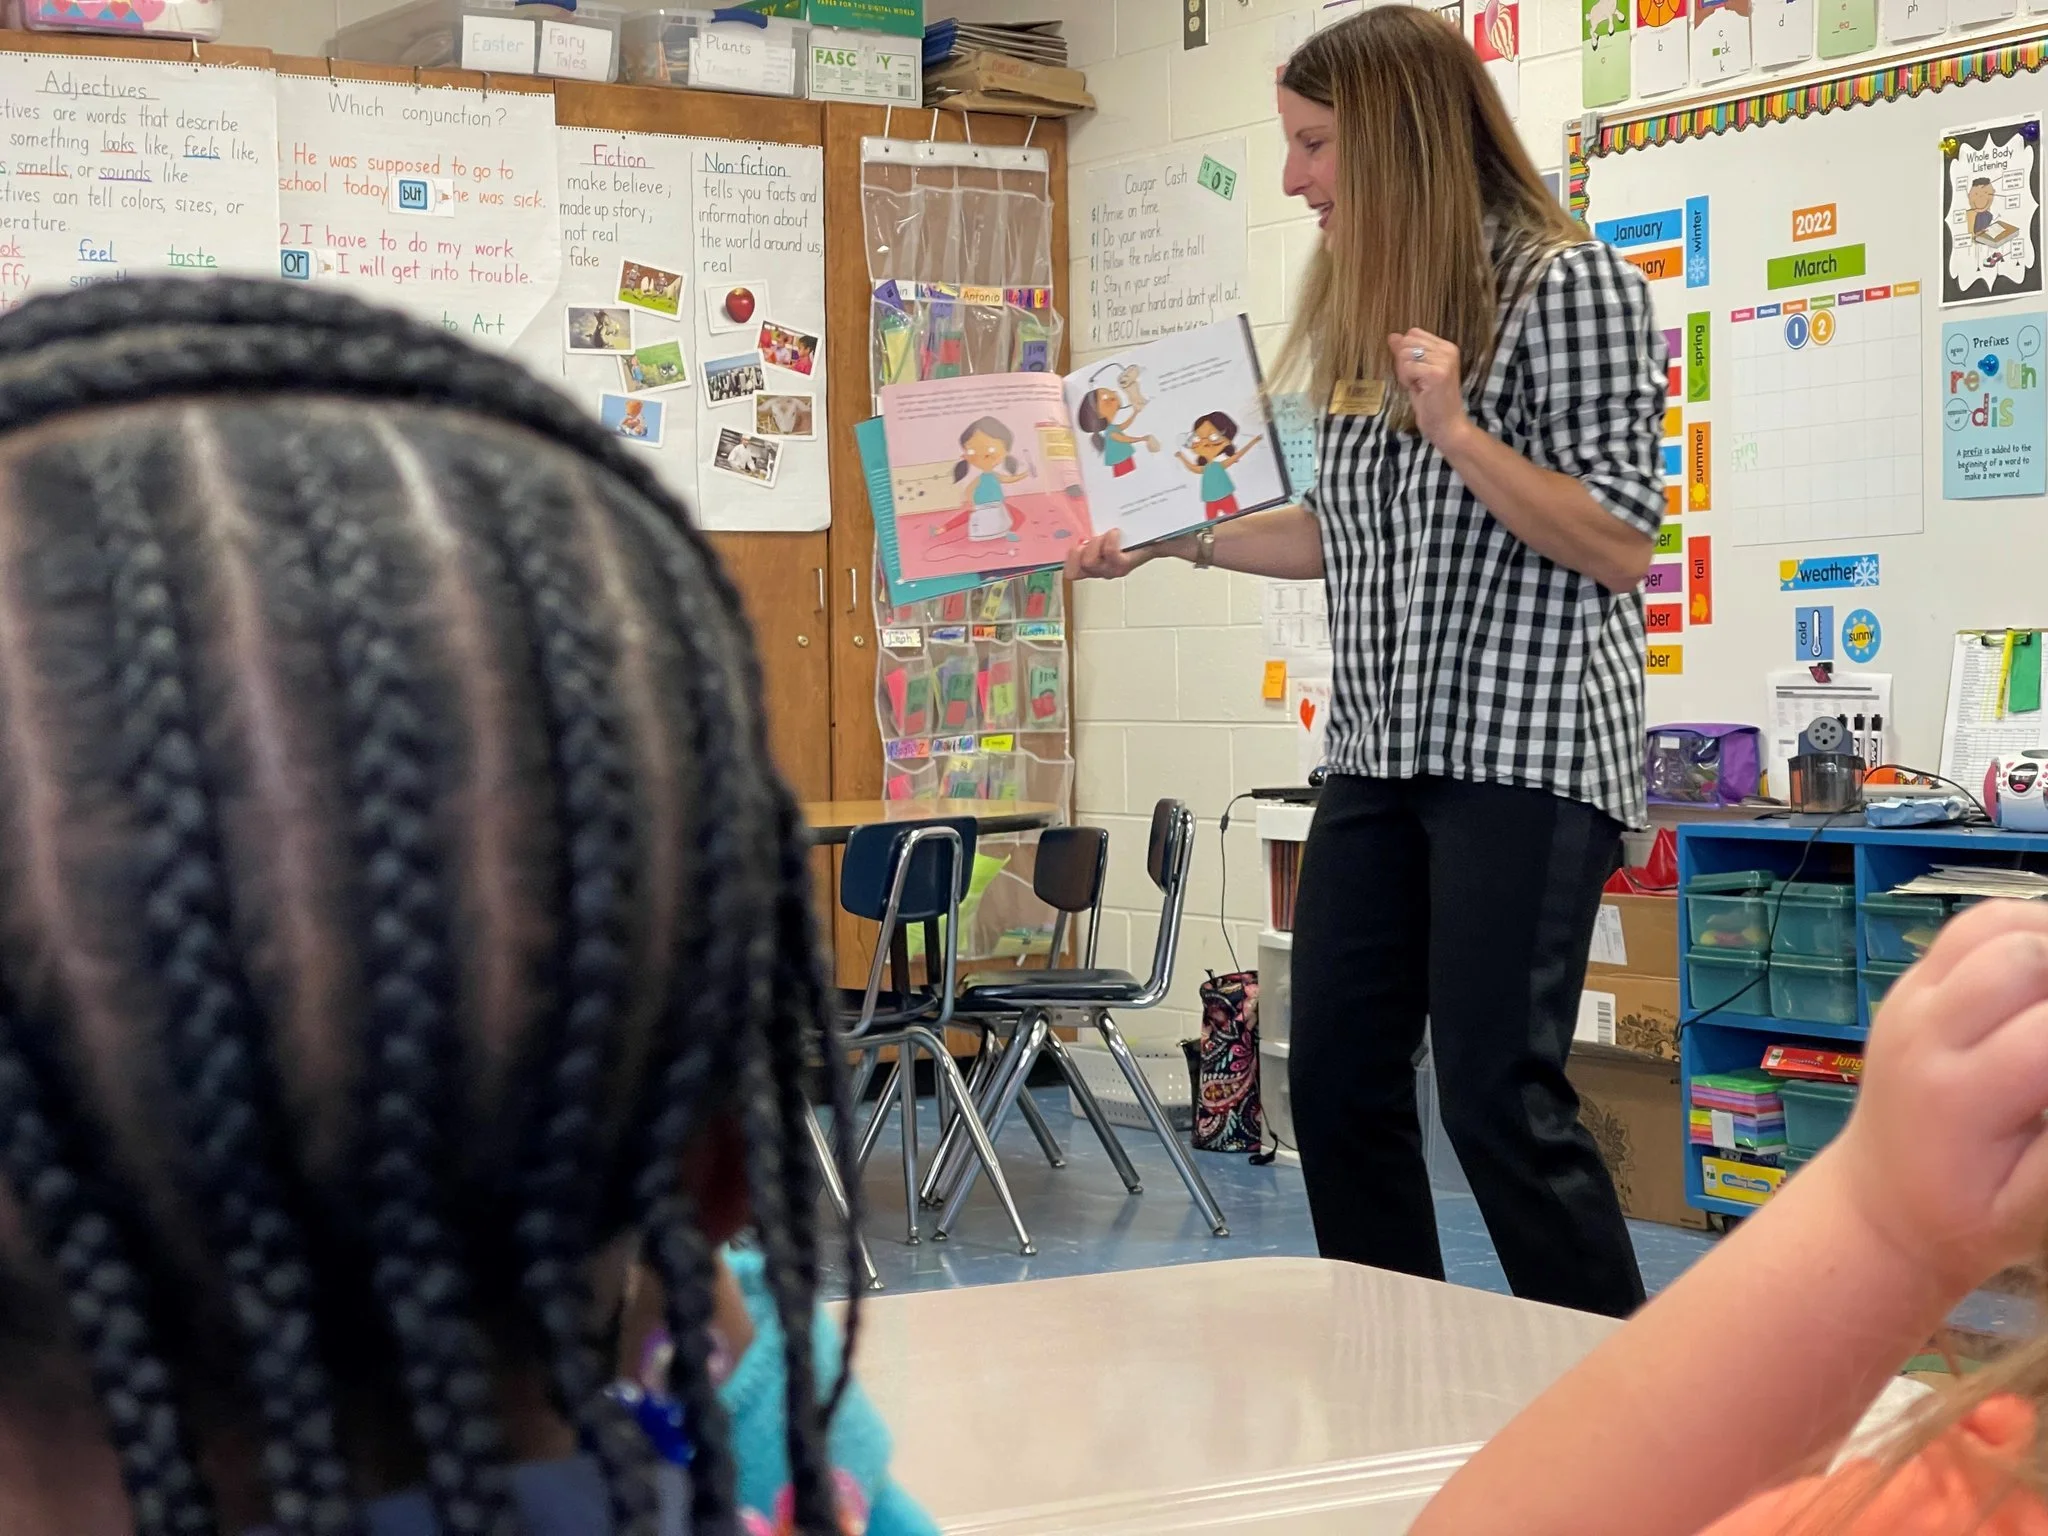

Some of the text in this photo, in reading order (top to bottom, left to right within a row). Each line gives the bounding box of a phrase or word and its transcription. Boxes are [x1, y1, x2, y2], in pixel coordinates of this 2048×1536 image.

[1779, 13, 1785, 27] d
[1908, 0, 1918, 19] ph
[472, 32, 524, 53] Easter
[549, 28, 585, 55] Fairy
[706, 34, 751, 55] Plants
[1658, 39, 1664, 52] b
[553, 52, 588, 70] Tales
[1720, 59, 1725, 72] k
[44, 70, 148, 100] Adjectives
[53, 105, 240, 132] are words that describe
[328, 92, 507, 127] Which conjunction?
[9, 125, 259, 164] something looks like, feels like,
[593, 143, 647, 169] Fiction
[1966, 146, 2014, 164] Whole Body
[16, 154, 72, 179] smells,
[77, 165, 94, 178] or
[99, 160, 152, 182] sounds
[163, 163, 188, 184] like
[294, 142, 514, 183] He was supposed to go to
[1973, 161, 2008, 173] Listening
[279, 171, 327, 193] school
[403, 185, 421, 201] but
[453, 181, 469, 202] he
[479, 189, 504, 206] was
[514, 190, 547, 210] sick.
[567, 171, 607, 193] make
[703, 177, 818, 204] tells you facts and
[1125, 164, 1188, 196] Cougar Cash
[53, 185, 245, 216] can tell colors, sizes, or
[559, 198, 609, 222] made up
[699, 203, 808, 229] information about
[1102, 204, 1124, 222] Arrive
[1128, 206, 1137, 218] on
[1796, 210, 1832, 236] 2022
[300, 224, 313, 245] I
[326, 225, 367, 248] have
[380, 229, 397, 250] to
[408, 232, 428, 253] do
[438, 242, 461, 260] my
[475, 239, 515, 258] work
[564, 222, 619, 243] not real
[700, 228, 721, 249] the
[726, 227, 760, 250] world
[764, 233, 802, 253] around
[1103, 228, 1115, 247] Do
[1118, 230, 1137, 248] your
[1614, 221, 1663, 241] January
[1693, 209, 1702, 253] winter
[78, 239, 115, 262] feel
[167, 243, 217, 268] taste
[569, 246, 600, 268] fake
[1103, 250, 1124, 271] Follow
[1128, 247, 1141, 266] the
[1144, 244, 1161, 264] rules
[1172, 239, 1185, 259] the
[1187, 234, 1205, 256] hall
[337, 253, 350, 274] I
[360, 253, 385, 277] will
[392, 260, 420, 284] get
[430, 262, 459, 281] into
[468, 261, 534, 285] trouble.
[703, 253, 732, 274] real
[1793, 253, 1837, 279] March
[964, 292, 1000, 303] Antonio
[1103, 274, 1122, 298] Stay
[1134, 277, 1150, 295] your
[1107, 299, 1127, 319] Raise
[1129, 301, 1146, 320] your
[1148, 291, 1166, 313] hand
[1168, 288, 1183, 308] and
[1208, 282, 1222, 306] yell
[472, 313, 505, 336] Art
[1818, 320, 1826, 336] 2
[1694, 324, 1706, 367] spring
[1973, 336, 2009, 348] Prefixes
[1951, 370, 1980, 394] re
[2006, 359, 2036, 390] un
[1972, 393, 2014, 428] dis
[1696, 428, 1704, 483] summer
[1962, 447, 1982, 458] prefix
[1991, 445, 2011, 454] added
[2013, 444, 2020, 452] to
[2021, 444, 2032, 452] the
[1958, 460, 1987, 473] beginning
[1989, 458, 1997, 467] of
[2005, 456, 2021, 465] word
[1964, 472, 1981, 480] make
[2003, 468, 2020, 478] word
[1694, 559, 1705, 579] fall
[1800, 563, 1858, 583] weather
[1798, 621, 1807, 645] cold
[1848, 630, 1875, 643] sunny
